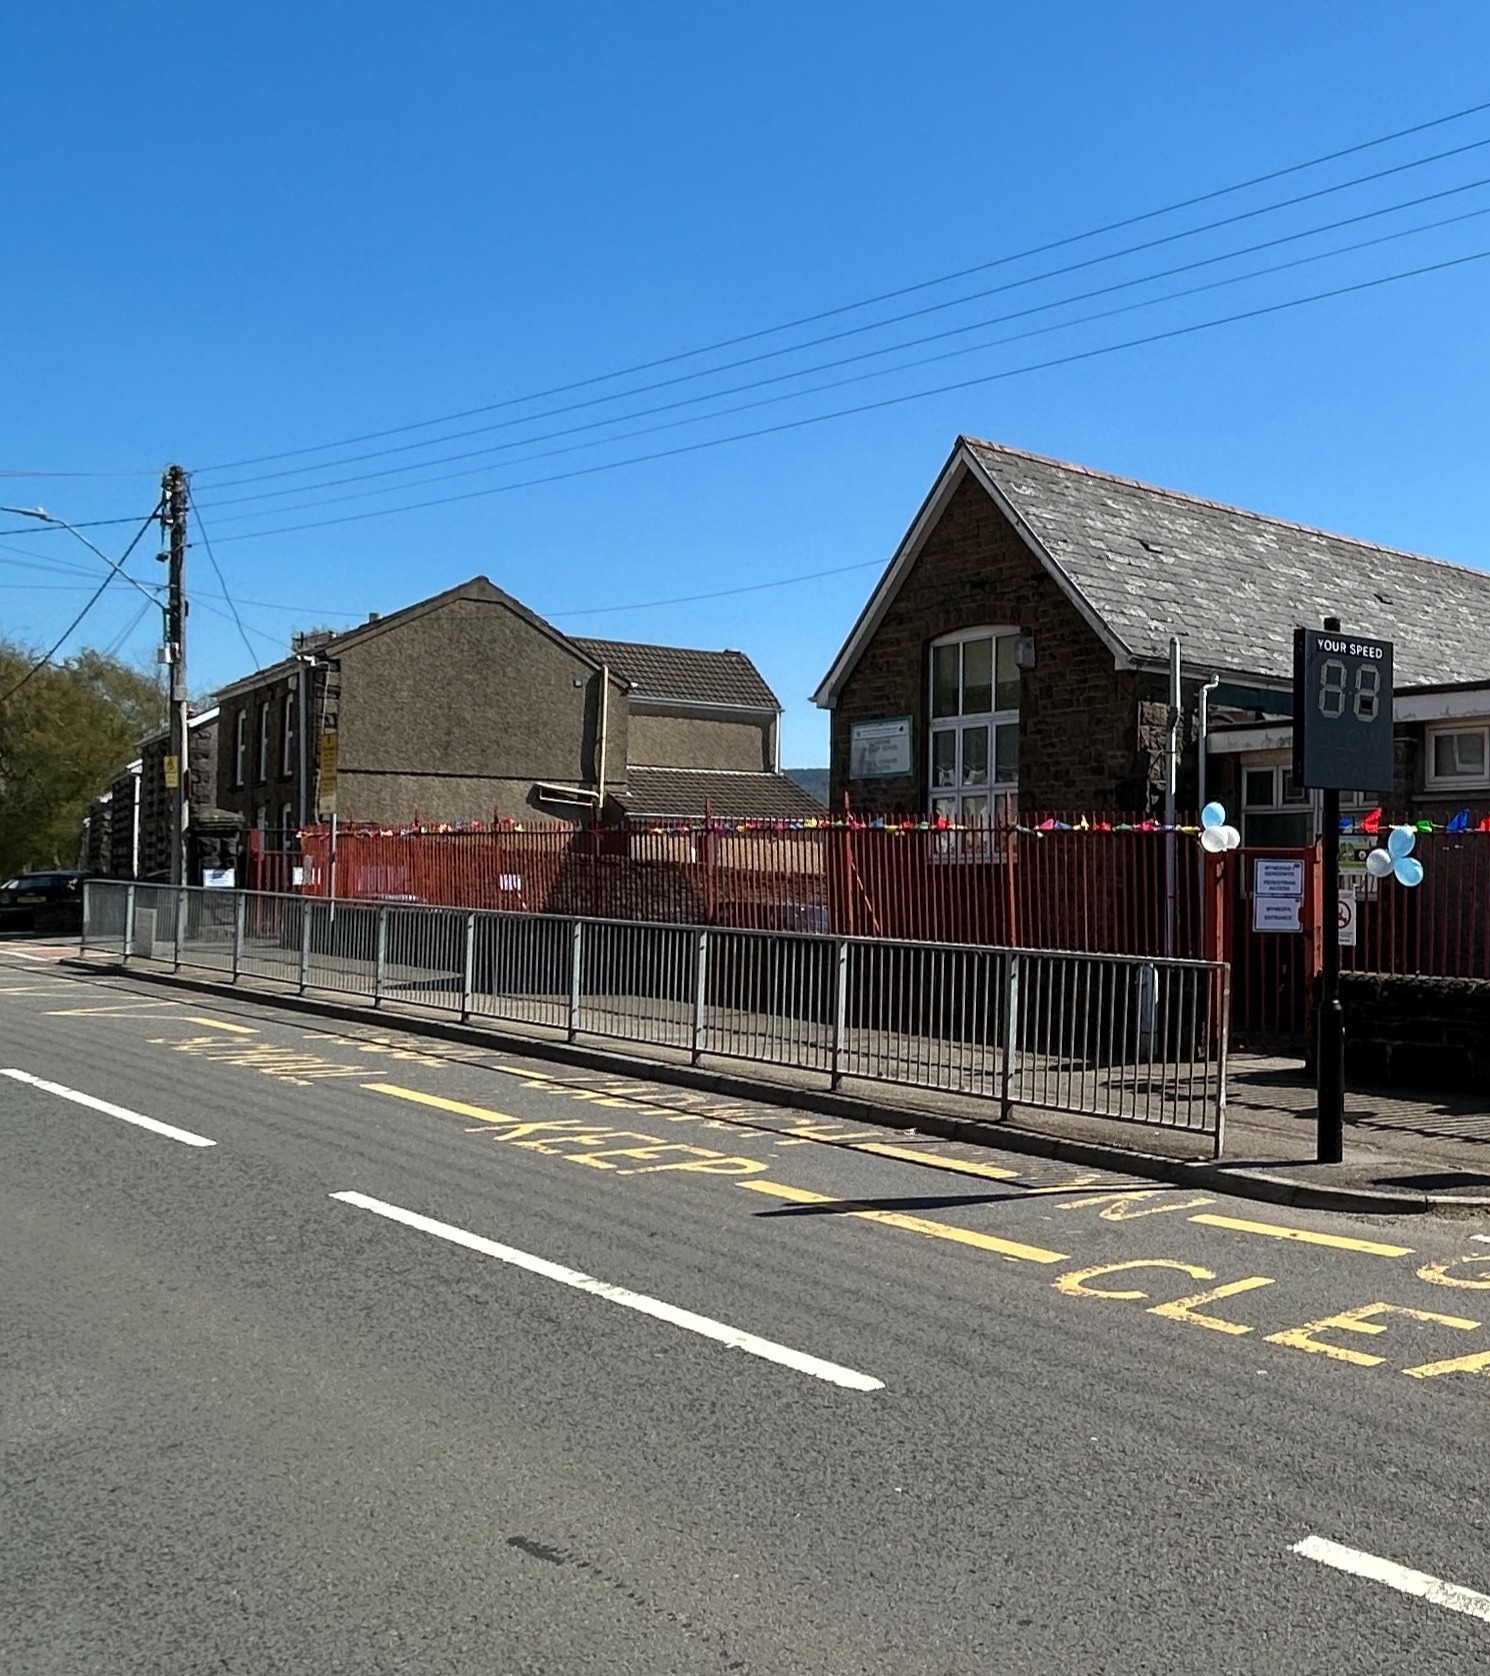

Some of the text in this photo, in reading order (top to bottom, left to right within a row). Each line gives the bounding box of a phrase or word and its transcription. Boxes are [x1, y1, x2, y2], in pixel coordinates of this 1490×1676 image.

[1317, 639, 1383, 660] YOUR SPEED
[464, 1119, 770, 1176] KEEP
